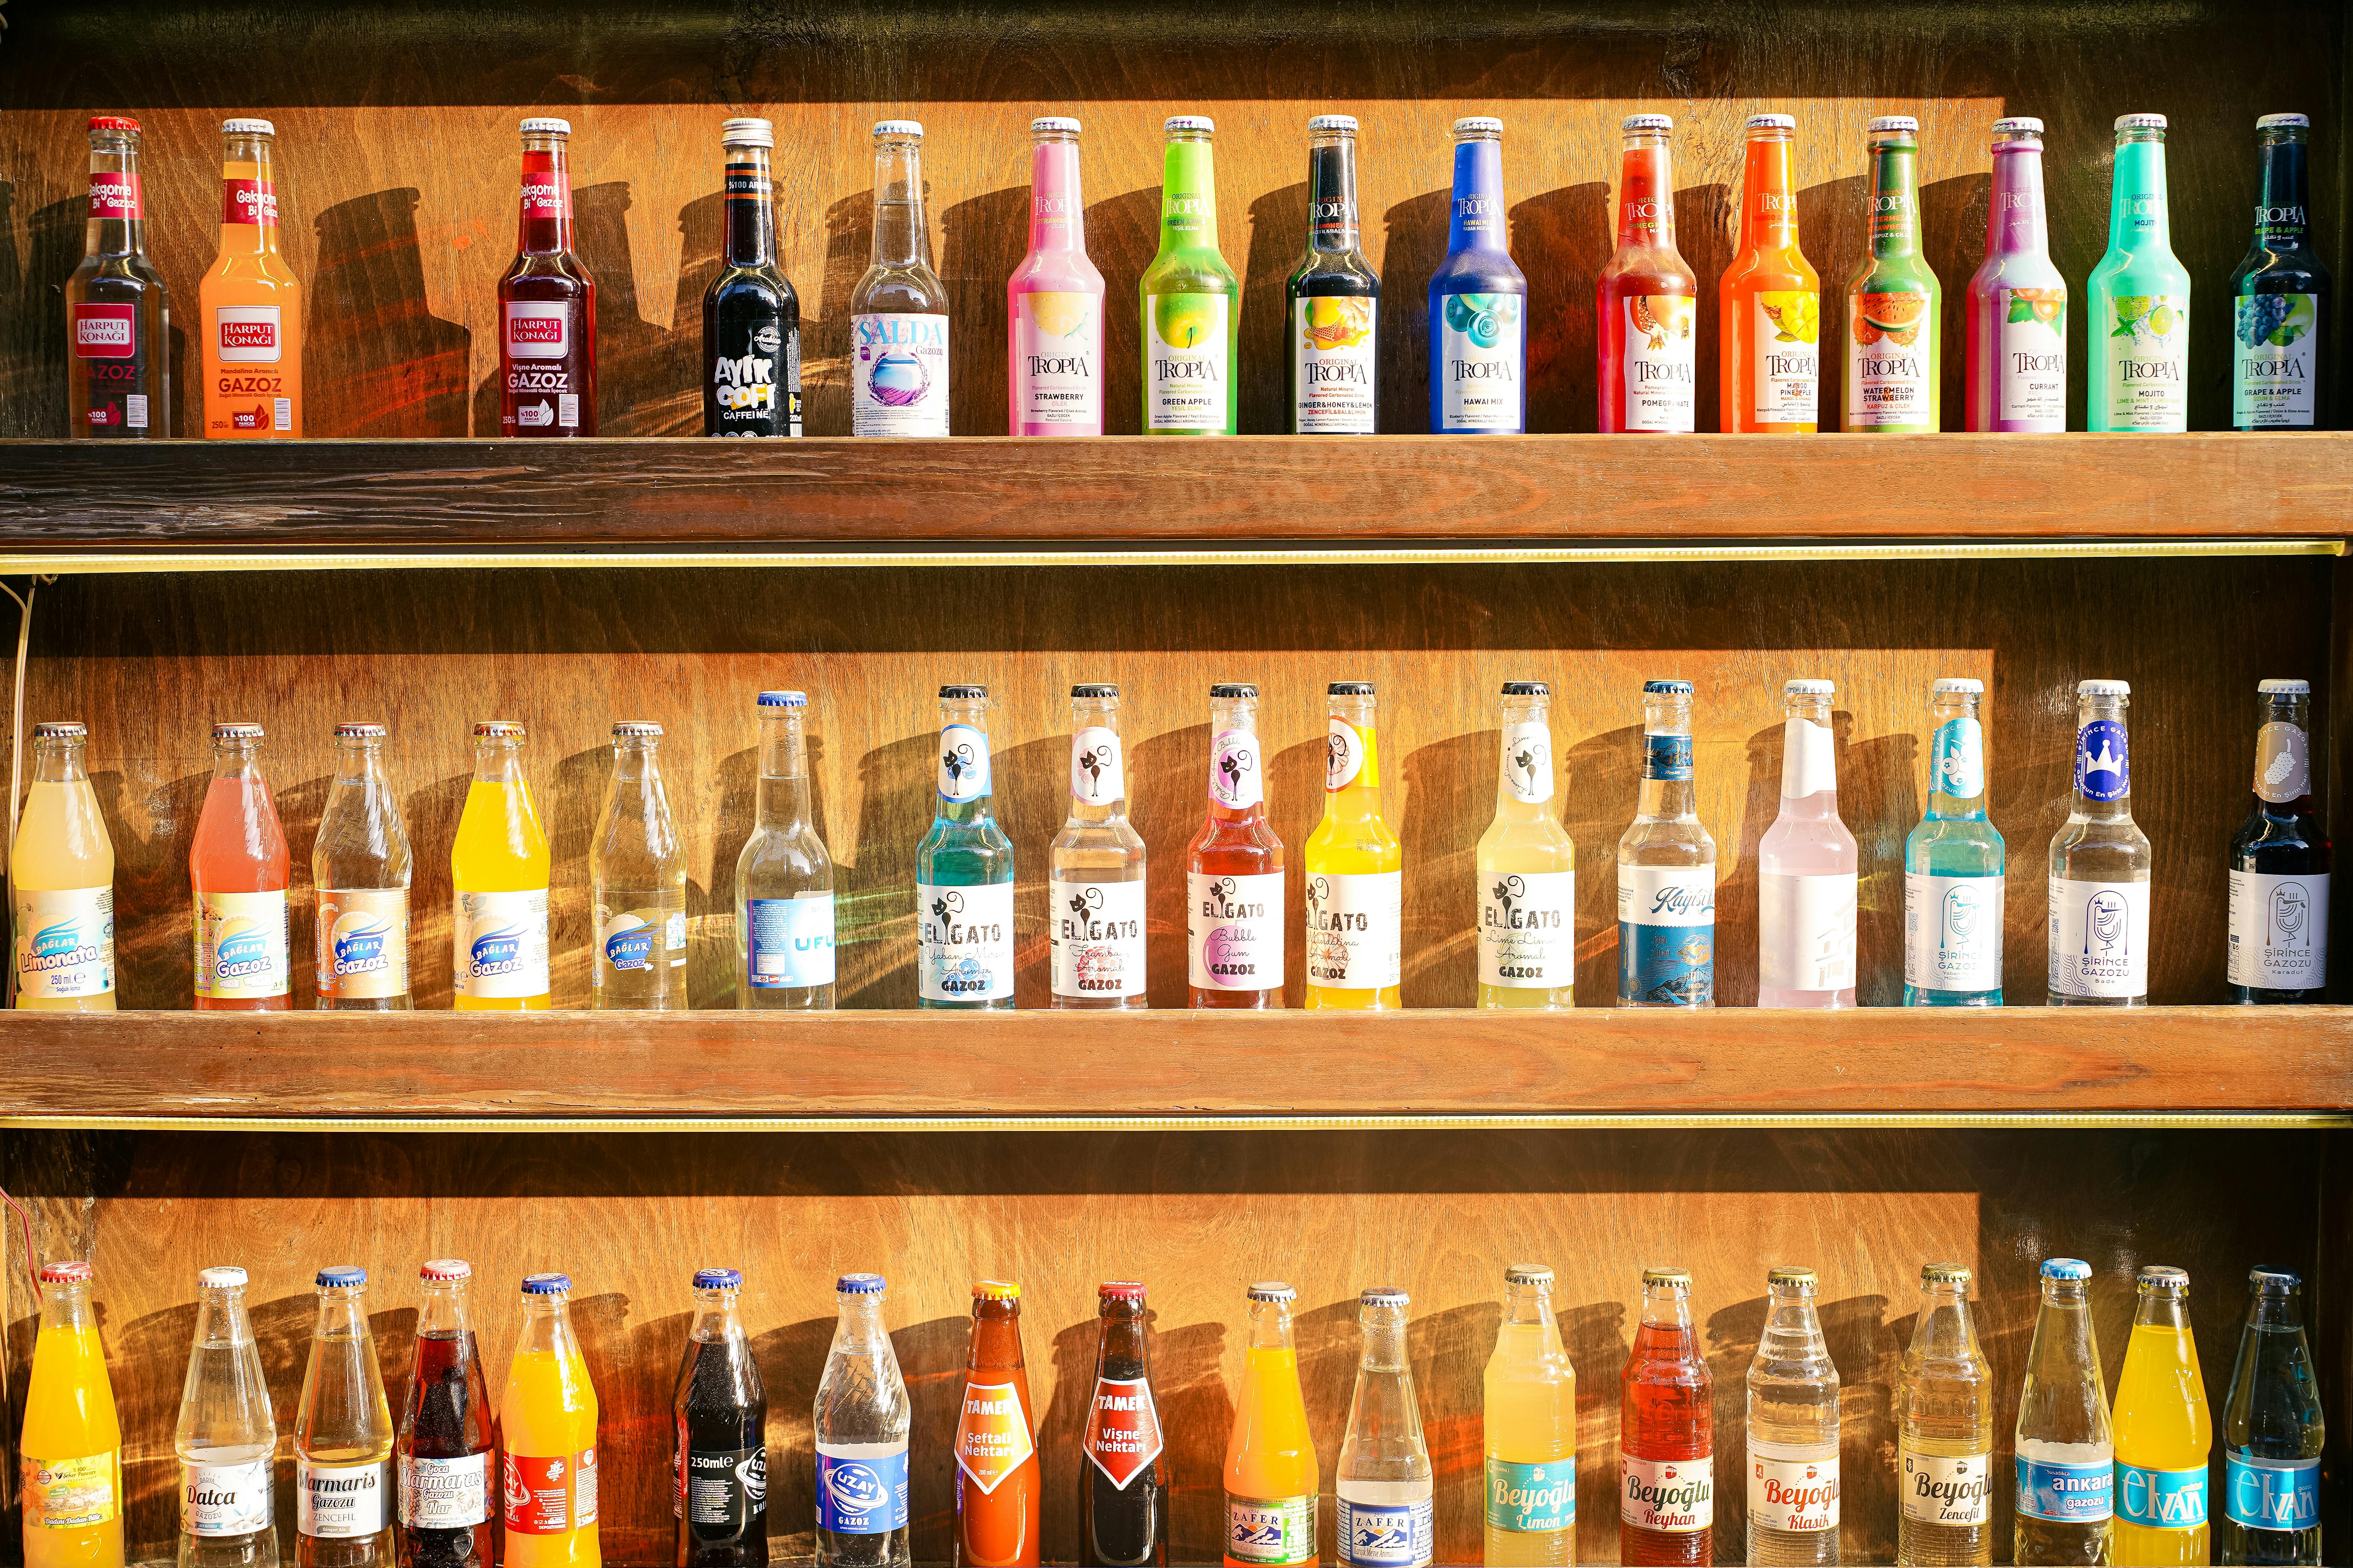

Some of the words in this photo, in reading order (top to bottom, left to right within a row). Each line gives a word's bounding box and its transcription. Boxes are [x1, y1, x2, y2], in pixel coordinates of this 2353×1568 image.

[92, 198, 100, 209] Bi
[1165, 197, 1211, 218] TROPIA
[1457, 198, 1502, 217] TROPIA
[2255, 205, 2306, 226] TROPIA
[80, 319, 127, 331] HARPUT
[224, 324, 273, 335] HARPUT
[514, 319, 560, 331] HARPUT
[859, 320, 943, 345] SALDA
[79, 332, 124, 343] KONAĞI
[225, 335, 271, 347] KONAĞI
[514, 330, 558, 342] KONAĞI
[916, 346, 943, 355] Gazozu
[1027, 355, 1089, 377] TROPIA
[1155, 360, 1218, 381] TROPIA
[1451, 360, 1513, 382] TROPIA
[1766, 355, 1817, 377] TROPIA
[1858, 357, 1921, 379] TROPIA
[2013, 353, 2065, 374] TROPIA
[2119, 360, 2179, 382] TROPIA
[2242, 358, 2305, 380] TROPIA
[508, 373, 568, 388] GAZOZ
[1305, 363, 1367, 384] TROPIA
[1634, 362, 1691, 384] TROPIA
[219, 378, 282, 393] GAZOZ
[724, 410, 770, 422] CAFFEINE
[1225, 903, 1264, 919] GATO
[1510, 909, 1561, 929] GATO
[951, 923, 1001, 944] GATO
[1090, 920, 1138, 941] GATO
[1210, 929, 1257, 942] Bubble
[36, 937, 77, 956] BAĞLAR
[1306, 933, 1359, 948] Mandalina
[223, 943, 264, 961] BAĞLAR
[339, 941, 382, 959] BAĞLAR
[476, 942, 517, 960] BAĞLAR
[609, 941, 650, 959] BAĞLAR
[1217, 943, 1250, 962] Gum
[1938, 950, 1983, 962] ŞİRİNCE
[2264, 948, 2311, 961] ŞİRİNCE
[21, 946, 97, 974] Limonata
[216, 957, 272, 978] Gazoz
[334, 954, 388, 976] Gazoz
[470, 957, 524, 978] Gazoz
[615, 957, 644, 969] Gazoz
[2081, 956, 2128, 970] ŞİRİNCE
[2263, 959, 2312, 968] GAZOZU
[1211, 963, 1256, 975] GAZOZ
[1311, 965, 1346, 980] GAZOZ
[1499, 966, 1543, 978] GAZOZ
[2081, 968, 2130, 977] GAZOZU
[941, 980, 985, 992] GAZOZ
[1078, 979, 1122, 991] GAZOZ
[967, 1399, 1014, 1416] TAMEK
[1099, 1395, 1147, 1411] TAMEK
[967, 1432, 1011, 1445] Şeftali
[1102, 1427, 1140, 1441] Vişne
[964, 1444, 1014, 1457] Nektarı
[1096, 1440, 1147, 1454] Nektarı
[427, 1462, 450, 1476] Goca
[837, 1471, 877, 1494] UZAY
[2052, 1471, 2113, 1493] ankara
[186, 1484, 236, 1508] Datça
[422, 1488, 454, 1502] Gazozu
[1627, 1474, 1711, 1512] Beyoğlu
[311, 1493, 356, 1511] Gazozu
[426, 1500, 452, 1515] Nar
[2066, 1495, 2104, 1510] gazozu
[45, 1517, 66, 1525] Dadını
[66, 1515, 88, 1524] Dadan
[195, 1511, 223, 1519] GAZOZU
[313, 1512, 356, 1522] ZENCEFİL
[838, 1516, 870, 1526] GAZOZ
[1233, 1511, 1279, 1525] ZAFER
[1356, 1517, 1404, 1528] ZAFER
[1515, 1513, 1560, 1529] Limon
[1644, 1509, 1695, 1530] Reyhan
[1788, 1514, 1830, 1529] Klasik
[1939, 1507, 1980, 1523] Zencefil
